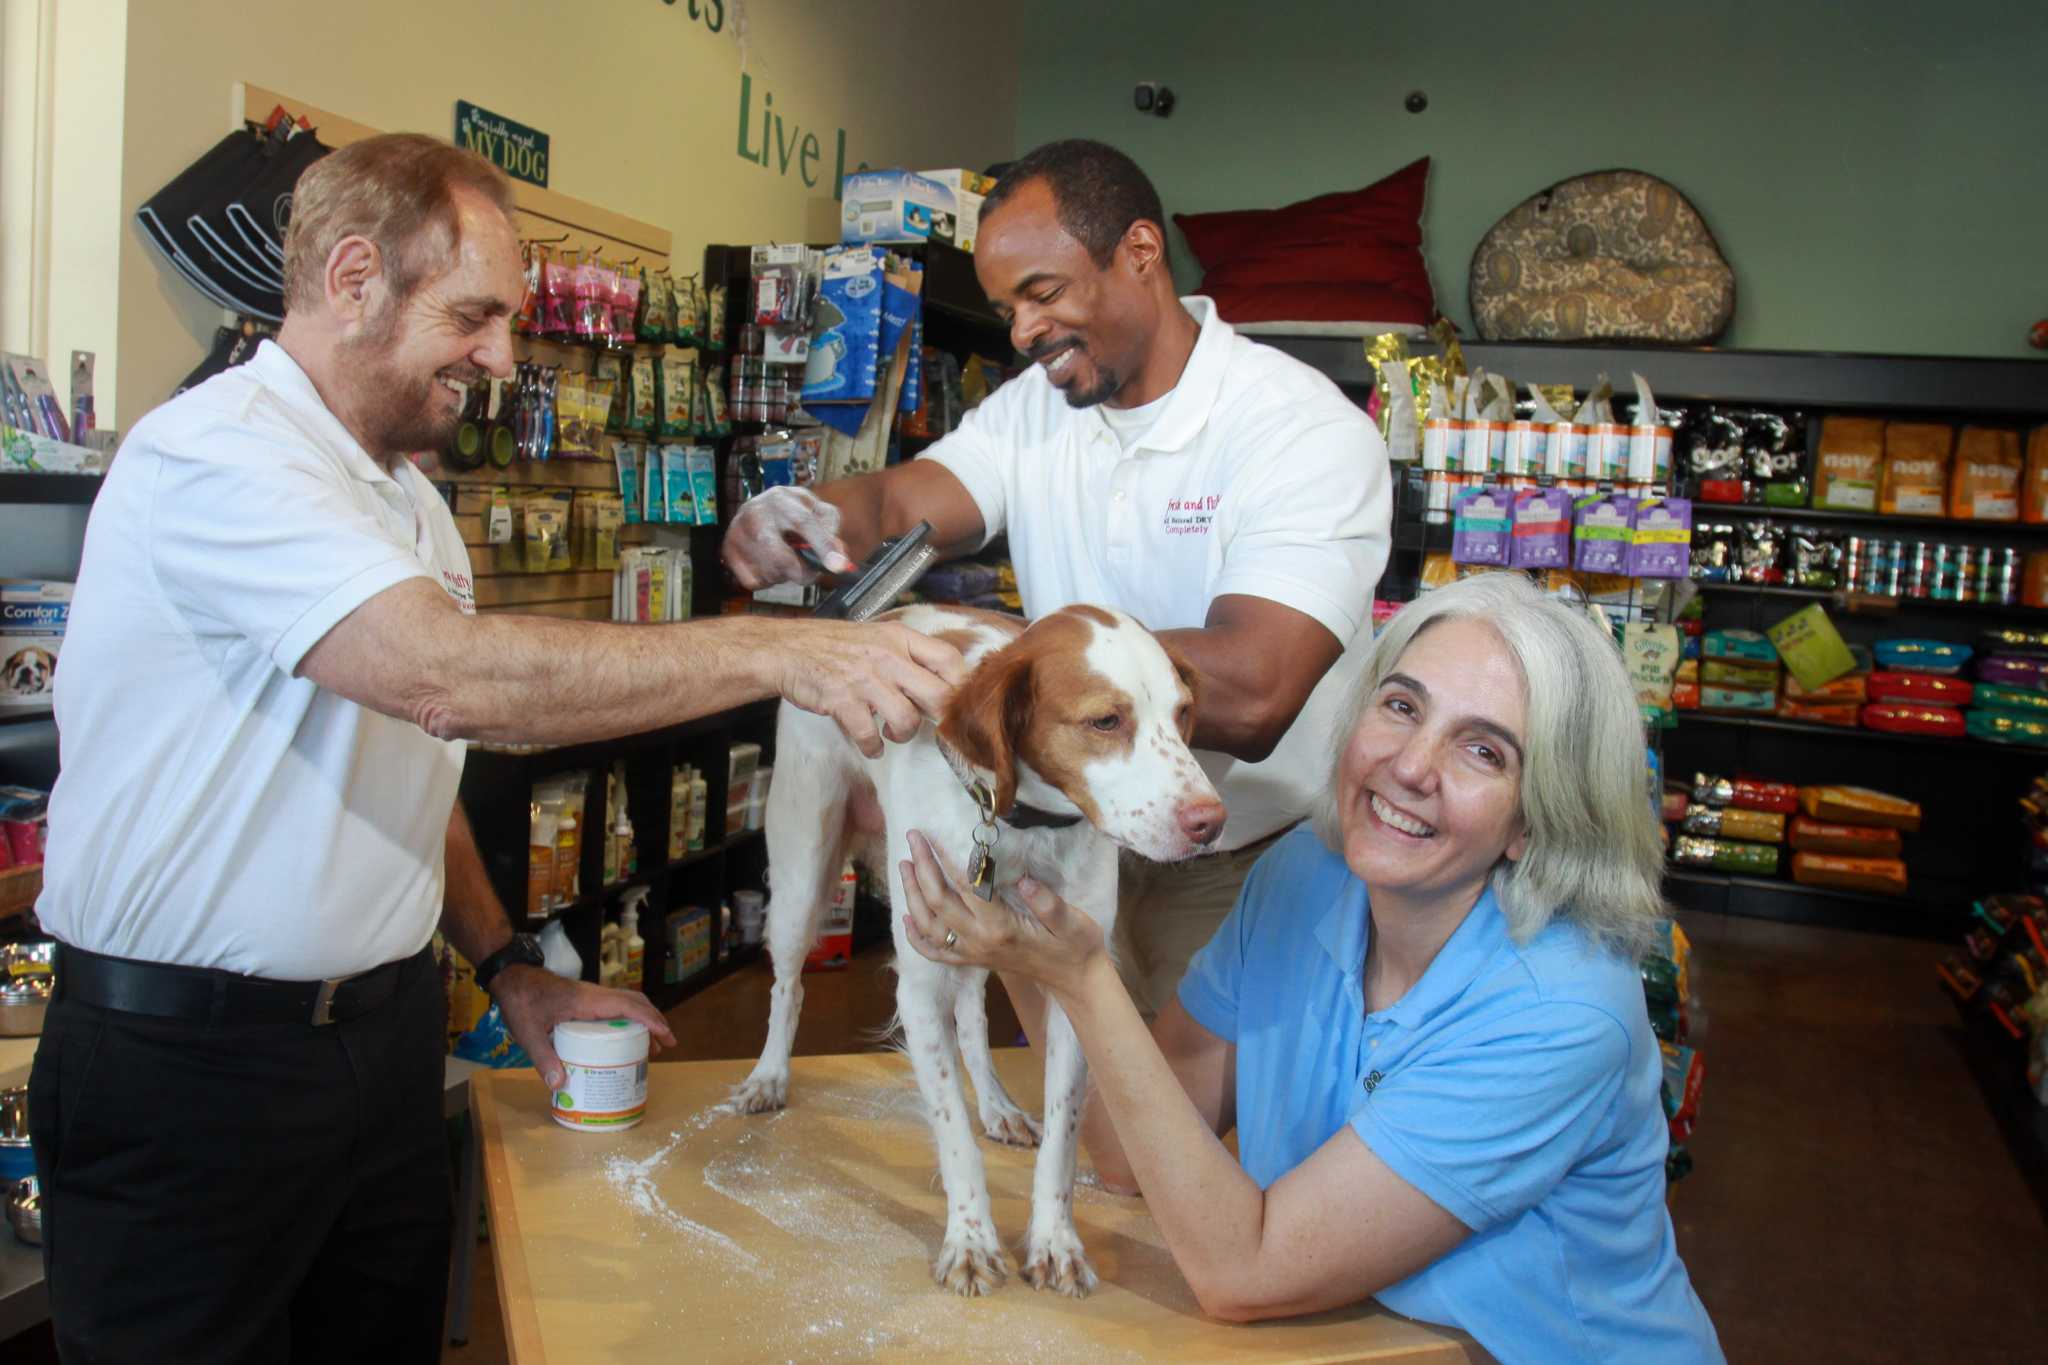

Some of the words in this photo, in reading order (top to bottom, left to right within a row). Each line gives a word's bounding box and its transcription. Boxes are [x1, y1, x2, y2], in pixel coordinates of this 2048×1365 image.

[737, 72, 820, 188] Live
[464, 127, 498, 161] MY
[503, 139, 545, 180] DOG
[1184, 497, 1203, 511] and
[1166, 525, 1208, 536] Completely
[3, 605, 60, 619] Comfort
